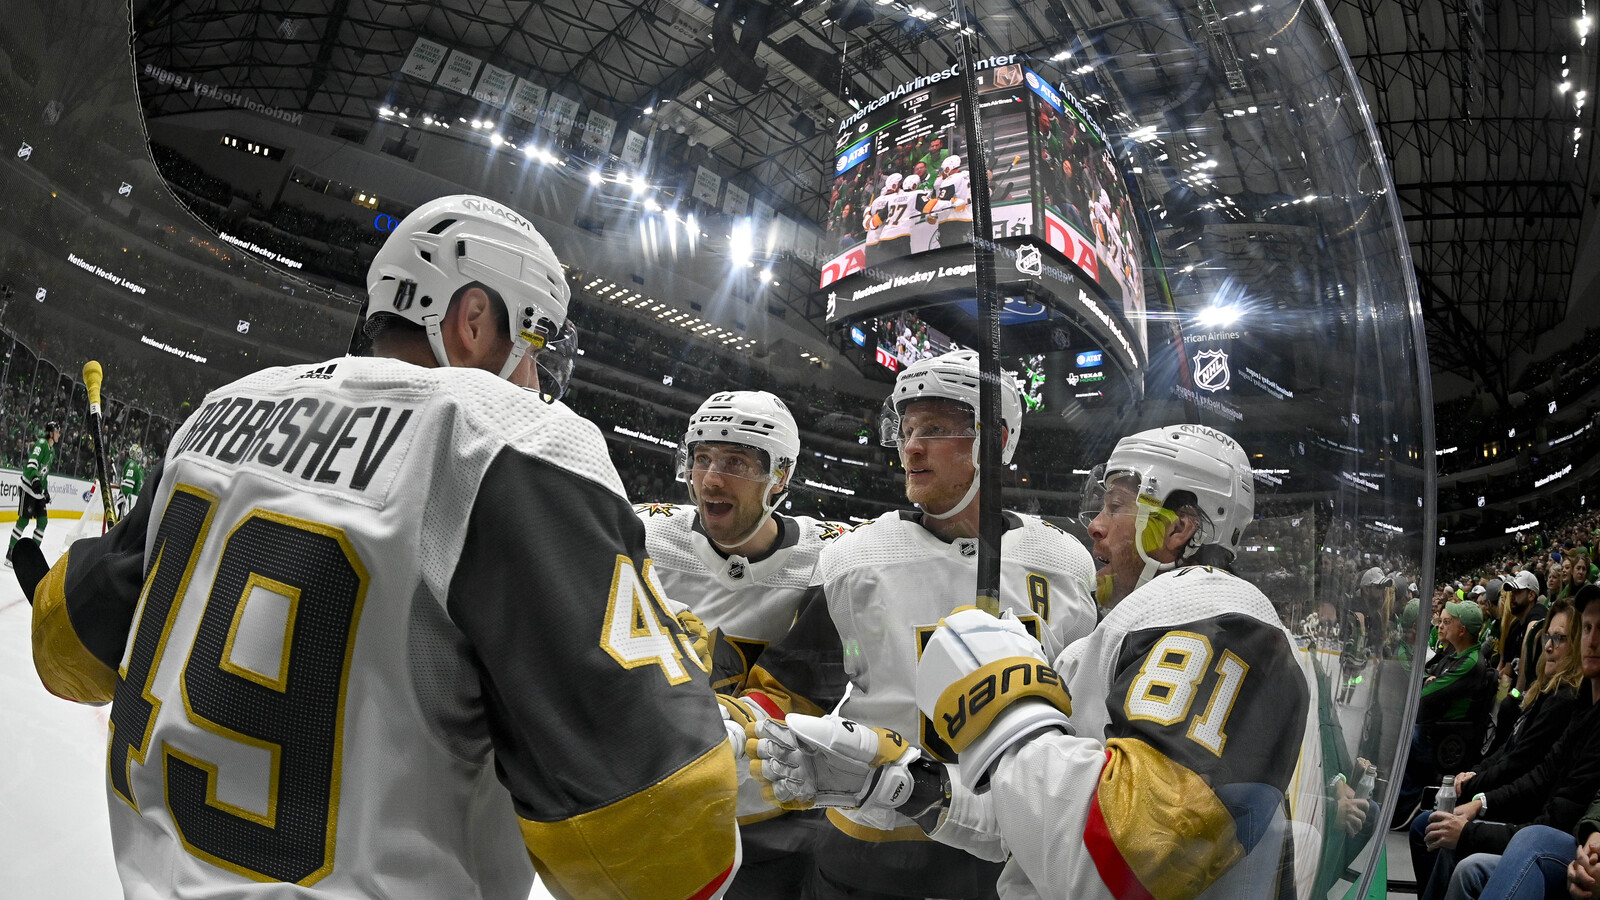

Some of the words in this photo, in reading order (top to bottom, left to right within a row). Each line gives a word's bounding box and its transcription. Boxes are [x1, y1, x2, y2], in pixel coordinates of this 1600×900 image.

[1040, 84, 1062, 107] AT&T
[847, 143, 870, 163] AT&T
[483, 203, 531, 231] NAQVI
[219, 231, 250, 250] National
[250, 242, 277, 260] Hockey
[277, 253, 303, 270] League
[67, 253, 96, 274] National
[95, 266, 121, 285] Hockey
[121, 277, 146, 295] League
[852, 279, 893, 301] National
[893, 269, 936, 288] Hockey
[938, 263, 977, 278] Leagu
[1208, 331, 1240, 341] Airlines
[1080, 371, 1104, 379] TEXAS
[699, 415, 734, 423] CCM
[1194, 425, 1236, 450] NAQVI
[599, 553, 708, 686] 4
[108, 483, 370, 887] 49
[1124, 630, 1250, 758] 81
